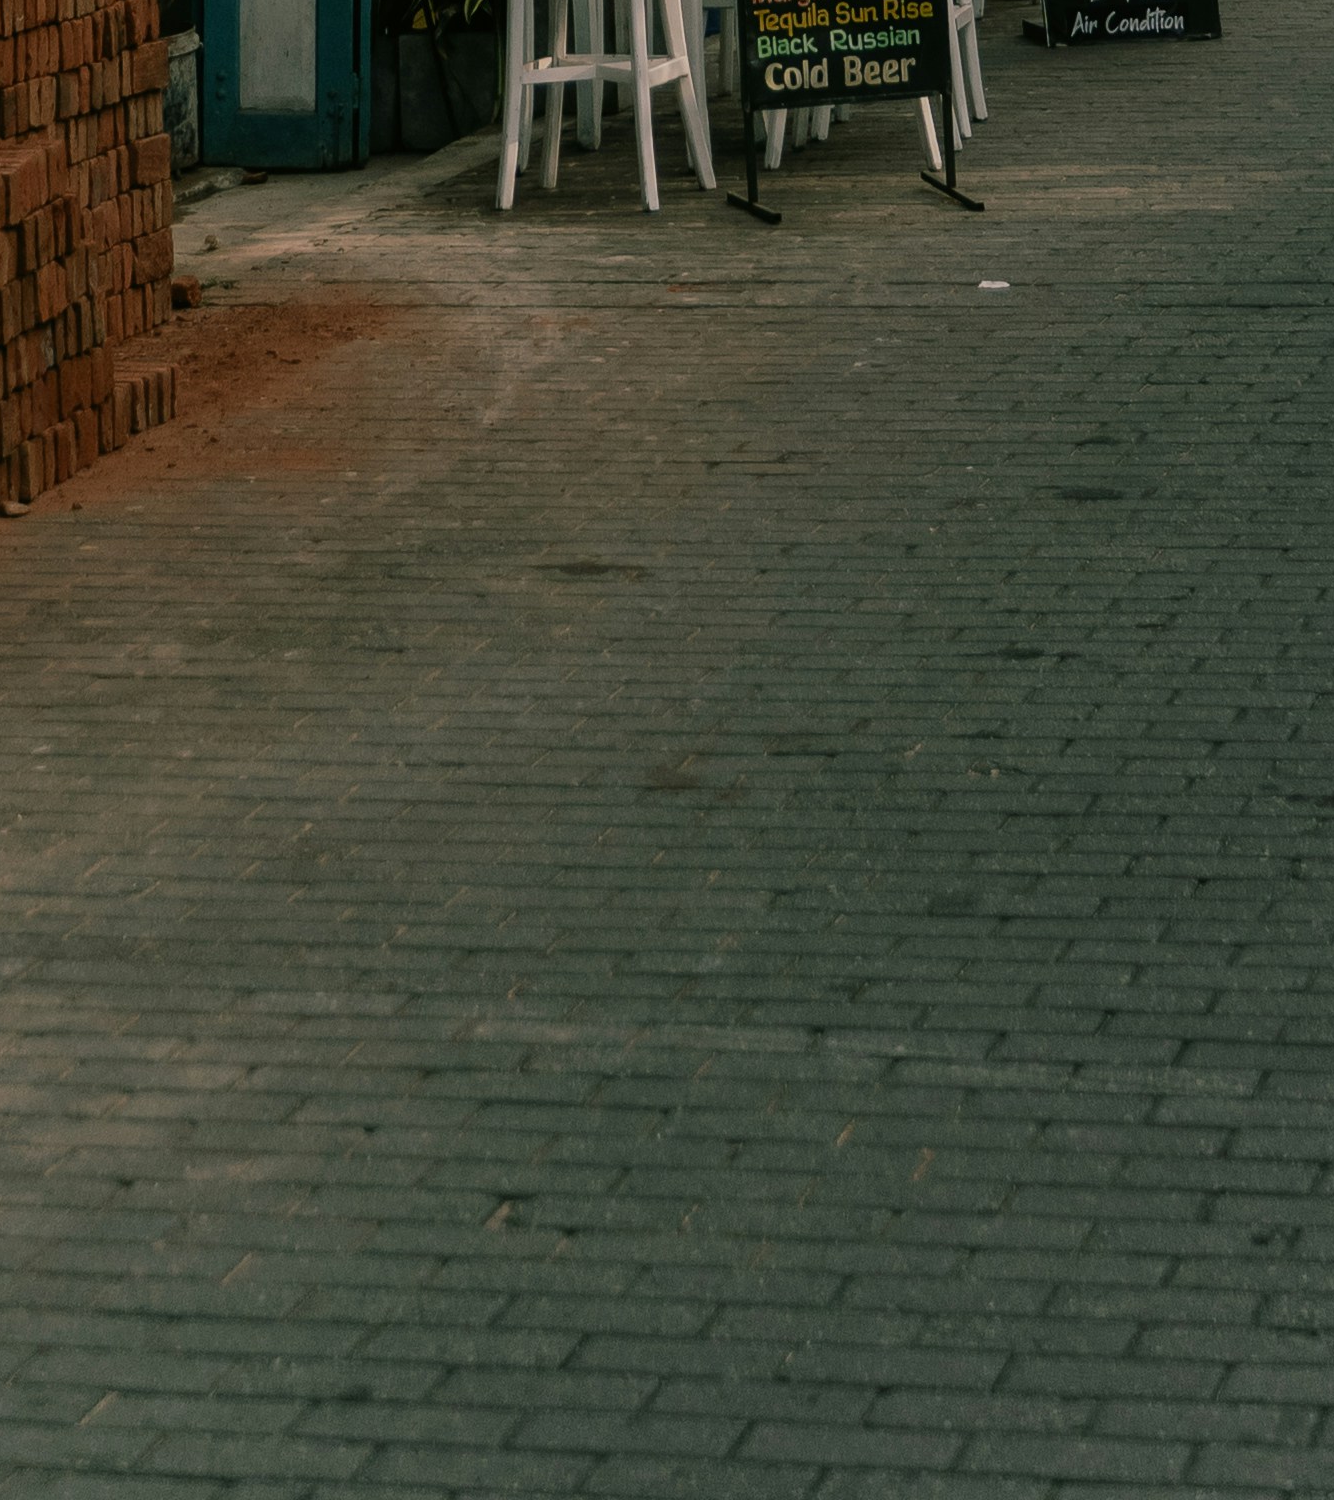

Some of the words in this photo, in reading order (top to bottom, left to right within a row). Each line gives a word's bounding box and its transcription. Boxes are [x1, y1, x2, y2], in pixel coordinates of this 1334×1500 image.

[753, 3, 830, 37] Tequila
[835, 1, 879, 25] Sun
[1070, 11, 1098, 37] Air
[1105, 6, 1185, 34] Condition
[757, 33, 818, 59] Black
[829, 26, 920, 51] Russian
[764, 57, 829, 91] Cold
[843, 55, 916, 88] Beer
